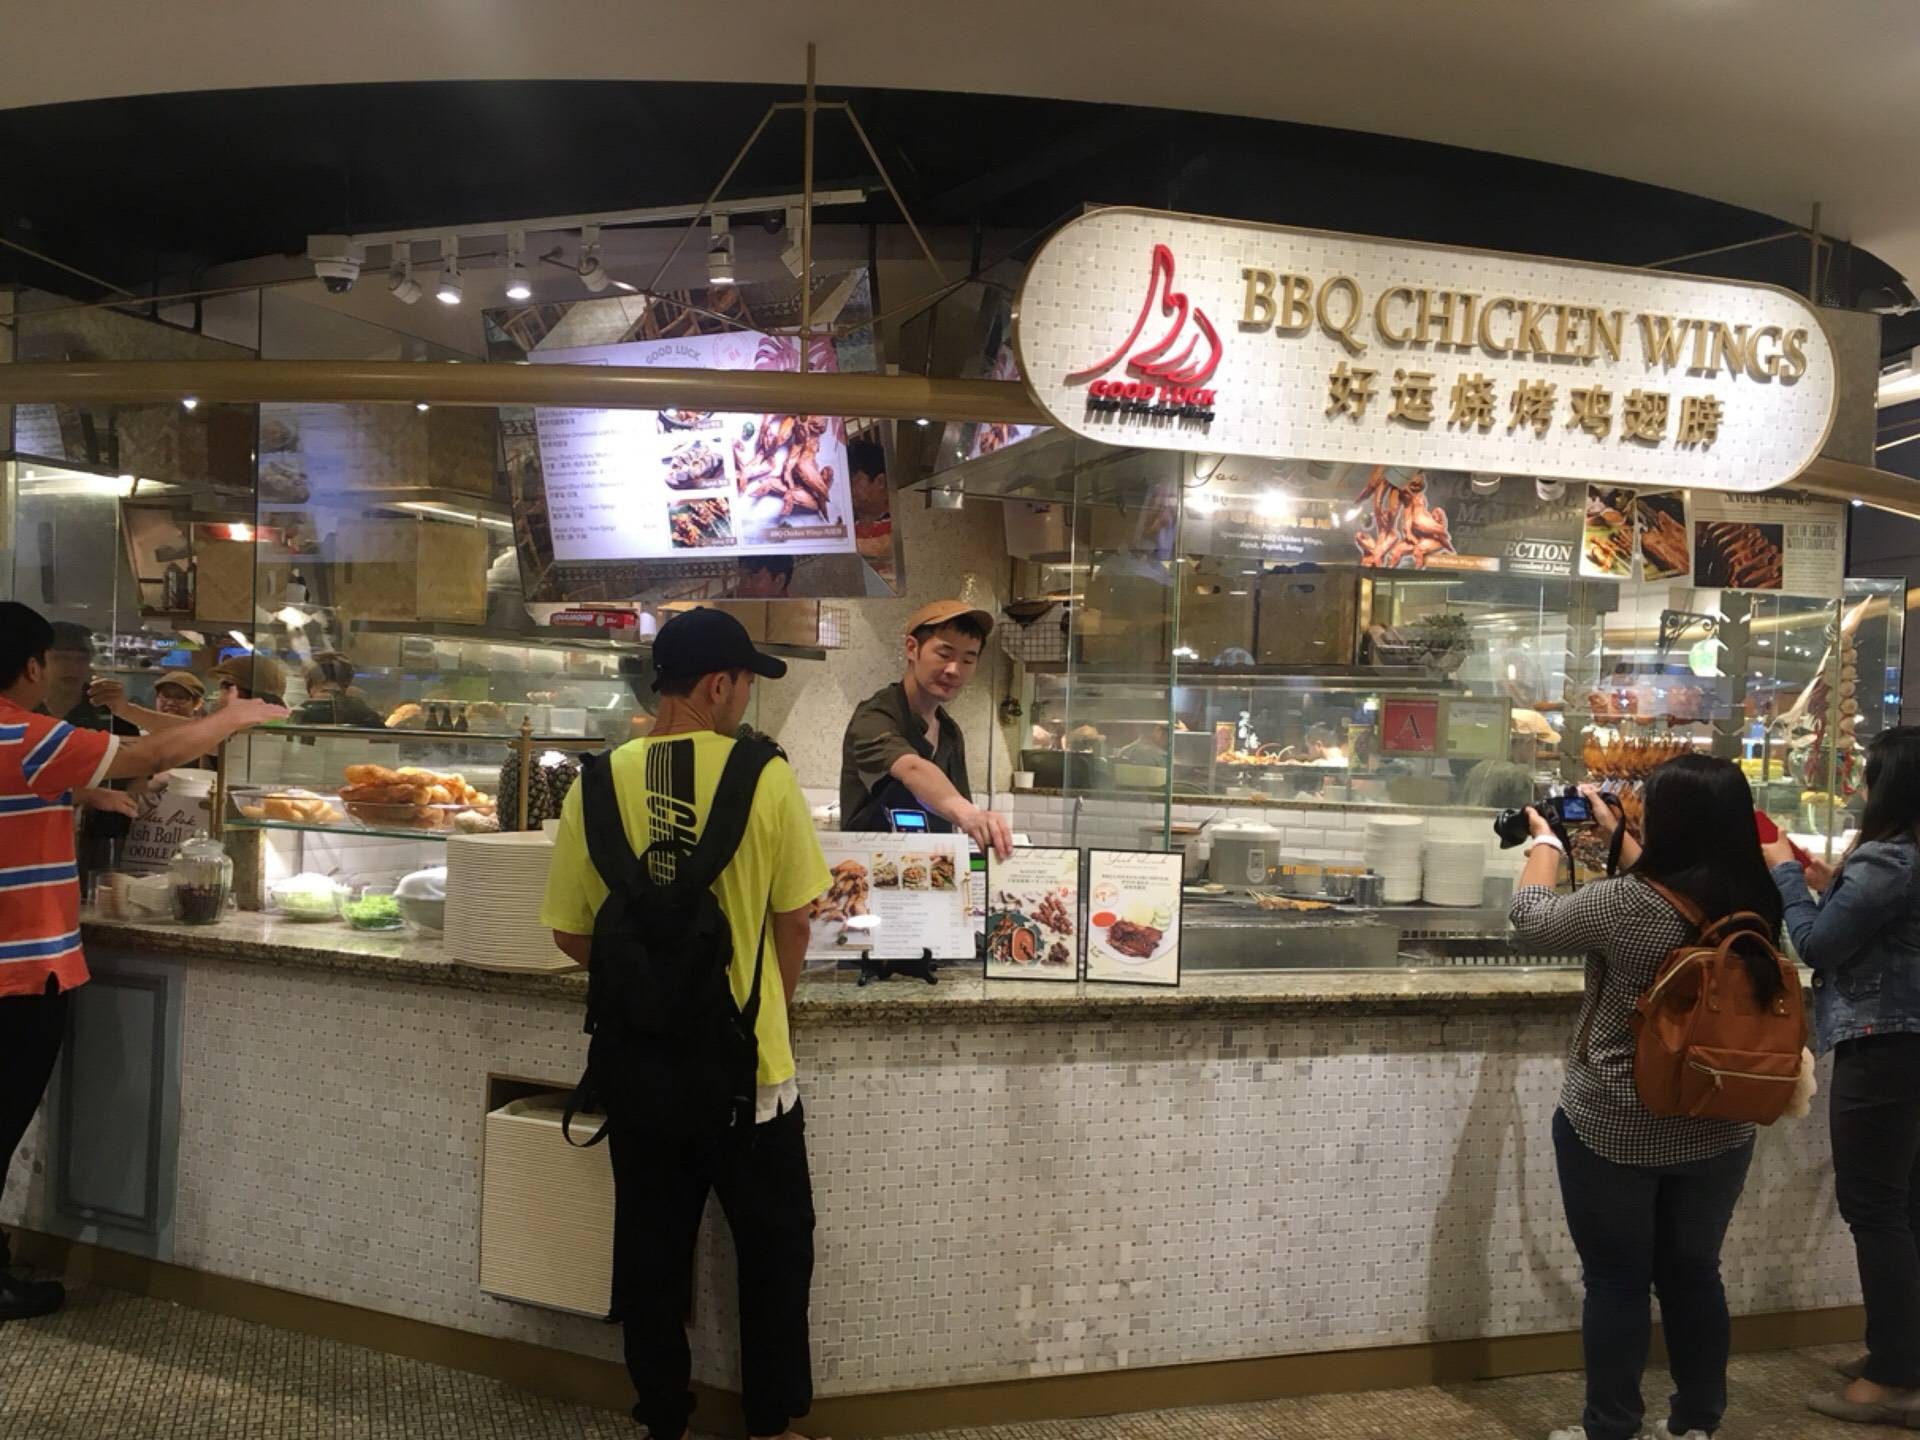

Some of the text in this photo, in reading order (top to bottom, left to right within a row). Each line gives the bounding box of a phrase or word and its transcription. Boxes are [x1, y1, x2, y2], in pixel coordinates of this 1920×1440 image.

[1237, 267, 1809, 385] BBQ CHICKEN WINGS
[645, 345, 673, 365] GOOD
[674, 343, 702, 362] LUCK
[1088, 379, 1217, 406] GOOD LUCK
[1324, 361, 1726, 451] 好运烧烤鸡翅膀
[155, 825, 183, 845] Ball
[129, 845, 169, 860] OODLE
